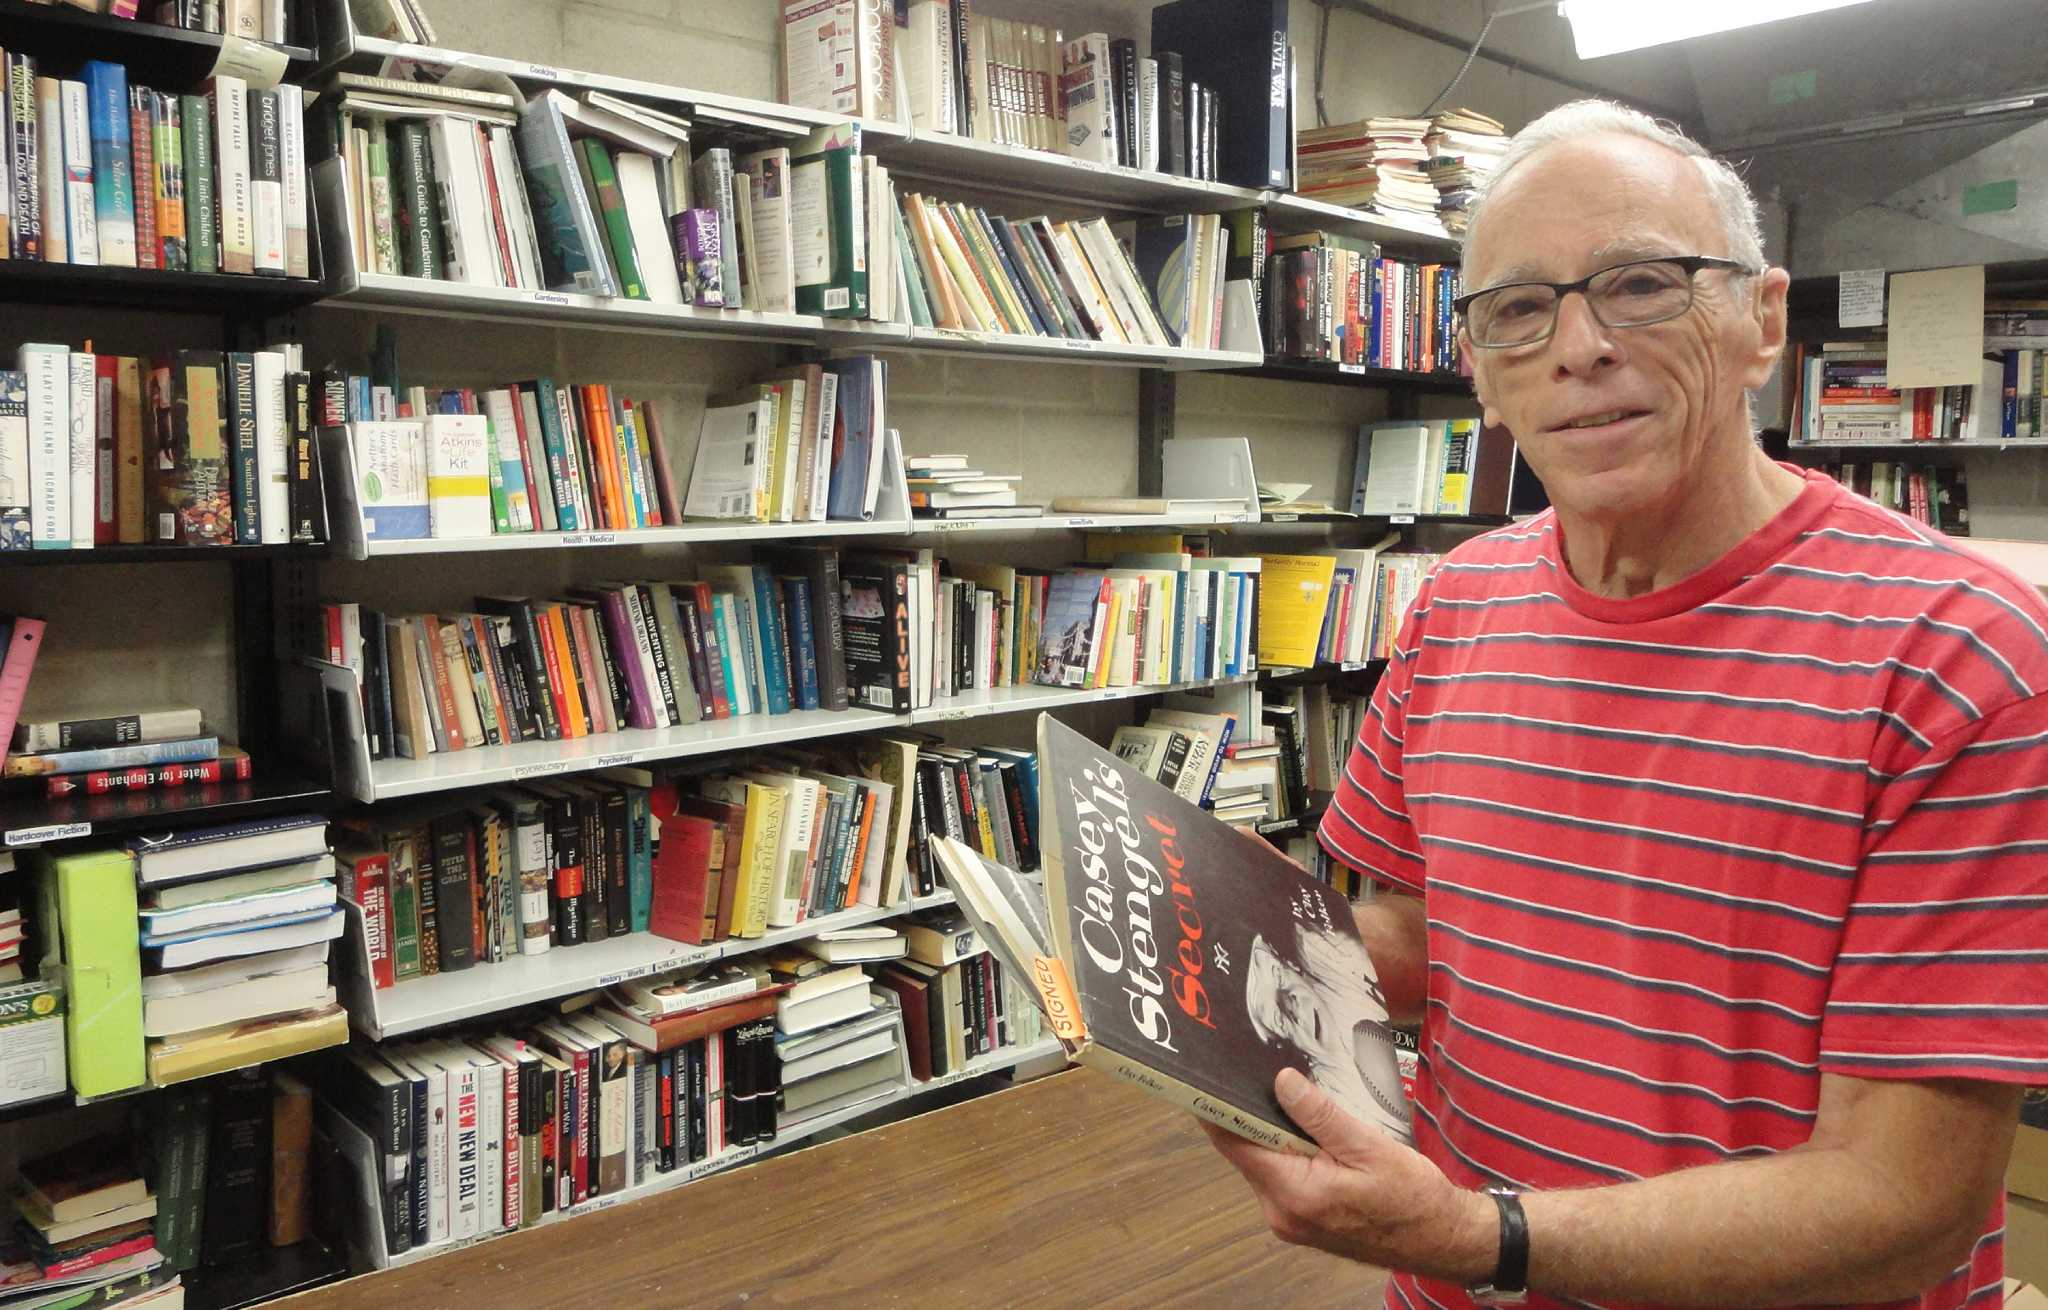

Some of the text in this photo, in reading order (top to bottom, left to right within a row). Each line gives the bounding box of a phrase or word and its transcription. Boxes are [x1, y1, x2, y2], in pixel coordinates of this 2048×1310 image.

[13, 64, 26, 122] WINSPEAR
[530, 65, 558, 79] Cooking
[1126, 47, 1135, 101] FLYBOYS
[1271, 31, 1283, 108] CIVIL WAR
[261, 96, 278, 177] bridget jones
[16, 152, 31, 236] LOVE AND DEATH
[199, 176, 210, 203] Little
[411, 133, 435, 280] Illustrated Guide to Gardening
[200, 206, 211, 247] Children
[702, 222, 712, 255] PLANT
[710, 222, 720, 257] GREAT
[535, 293, 569, 305] Gardening
[42, 354, 57, 540] THE LAY OF THE LAND RICHARD FORD
[236, 362, 258, 525] DANIELLE STEEL Southern Lights
[440, 435, 483, 449] Atkins
[449, 457, 469, 470] Kit
[567, 453, 576, 469] Diet
[555, 478, 567, 509] REVEALED
[562, 535, 616, 545] Health Medical
[827, 591, 842, 651] PSYCHOLOGY
[647, 615, 675, 705] INVENTING MONEY
[96, 766, 210, 788] Water for Elephants
[1202, 728, 1231, 801] HOW TO AVOID PROBATE!
[771, 793, 782, 804] IN
[8, 824, 88, 843] Hardcover Fiction
[633, 816, 647, 856] China
[764, 807, 780, 850] SEARCH
[1069, 776, 1124, 974] Casey
[364, 887, 381, 961] THE WORLD
[567, 897, 578, 939] Mystique
[758, 876, 775, 928] HISTORY
[1084, 758, 1179, 1054] Stengel's
[1143, 811, 1218, 1031] Secret
[1291, 897, 1304, 920] by
[1300, 885, 1316, 919] Clay
[1313, 889, 1337, 937] Felker
[599, 967, 646, 985] History World
[1034, 957, 1073, 1032] SIGNED
[563, 1072, 572, 1135] STATE OF WAR
[1117, 1065, 1164, 1092] Clay Felker
[579, 1067, 590, 1158] THE FINAL DAYS
[1192, 1096, 1281, 1146] Casey Stengel's
[459, 1083, 477, 1201] THE NEW NEW DEAL
[507, 1065, 520, 1228] NEW RULES BILL MAHER
[418, 1178, 428, 1230] NATURAL
